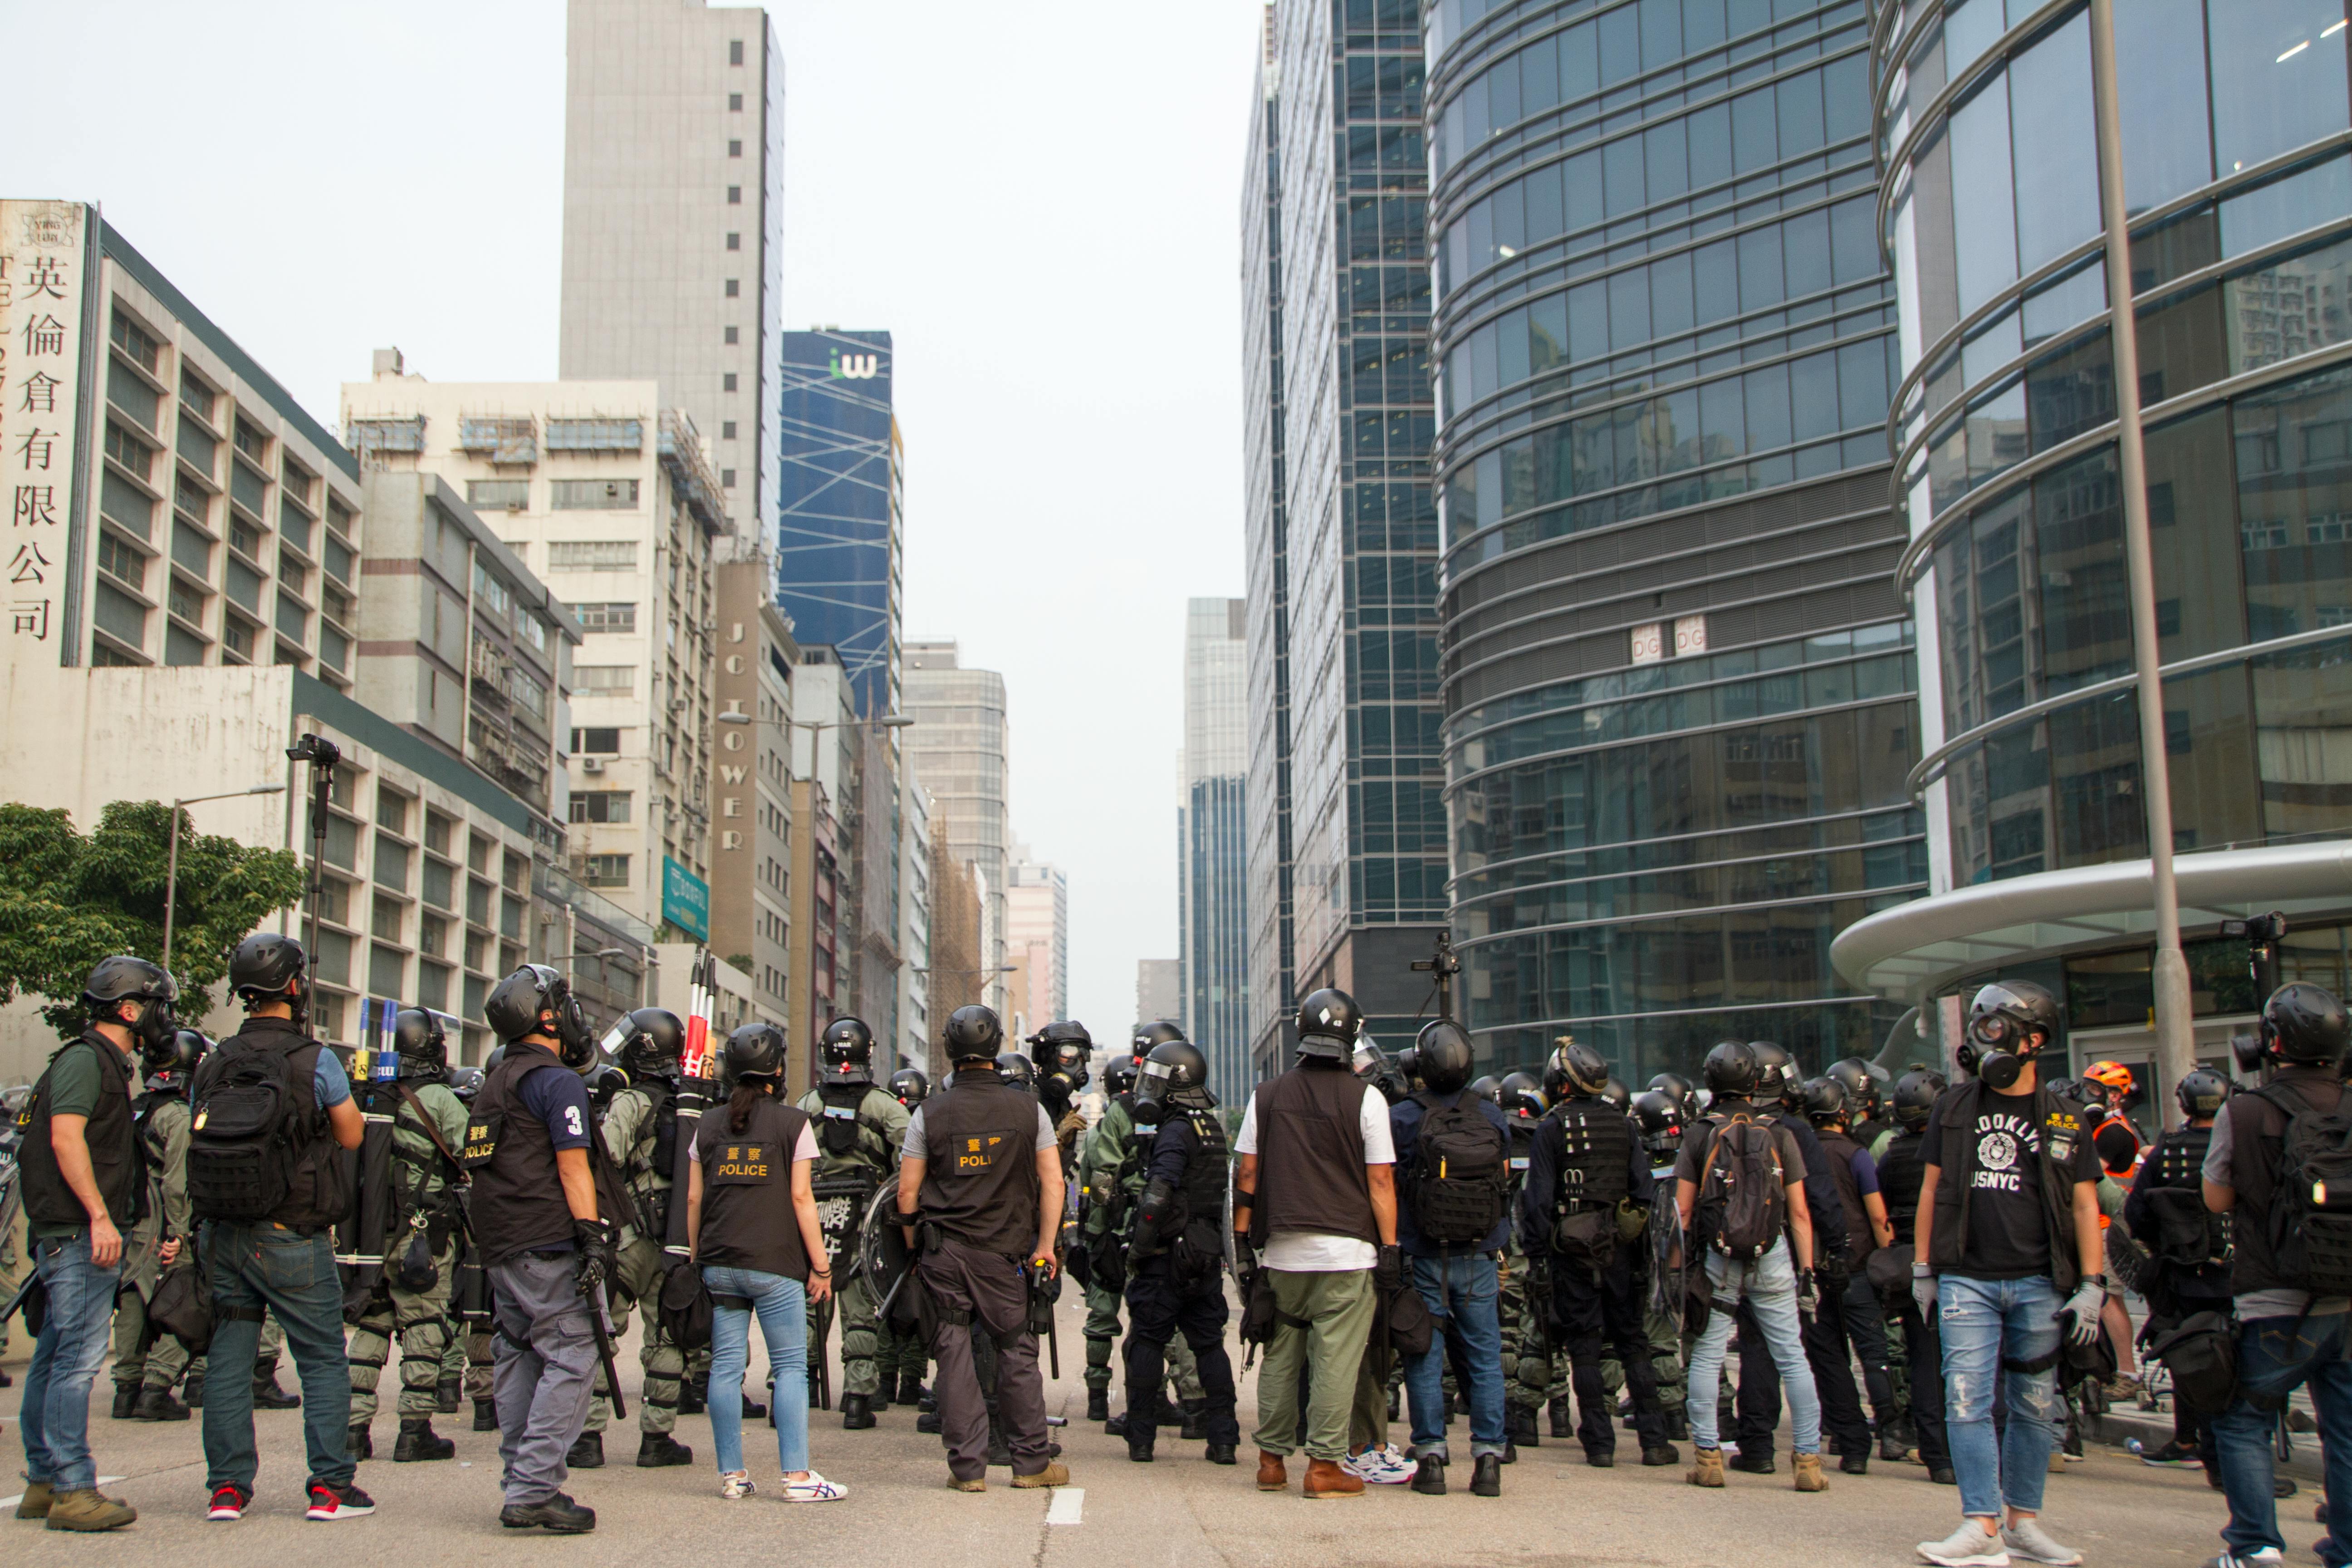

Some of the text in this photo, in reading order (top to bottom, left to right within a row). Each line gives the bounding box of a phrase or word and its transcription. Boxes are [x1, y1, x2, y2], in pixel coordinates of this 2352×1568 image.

[35, 221, 61, 230] YING
[38, 233, 58, 242] LUN
[7, 256, 69, 641] 英倫倉有限公司
[1677, 629, 1703, 649] DG
[1634, 638, 1658, 657] DG
[719, 699, 748, 851] TOWER
[565, 1106, 583, 1135] 3
[2046, 1119, 2080, 1131] POLICE
[470, 1125, 488, 1141] 警察
[465, 1143, 495, 1159] POLICE
[727, 1147, 761, 1161] 警察
[718, 1164, 767, 1176] POLICE
